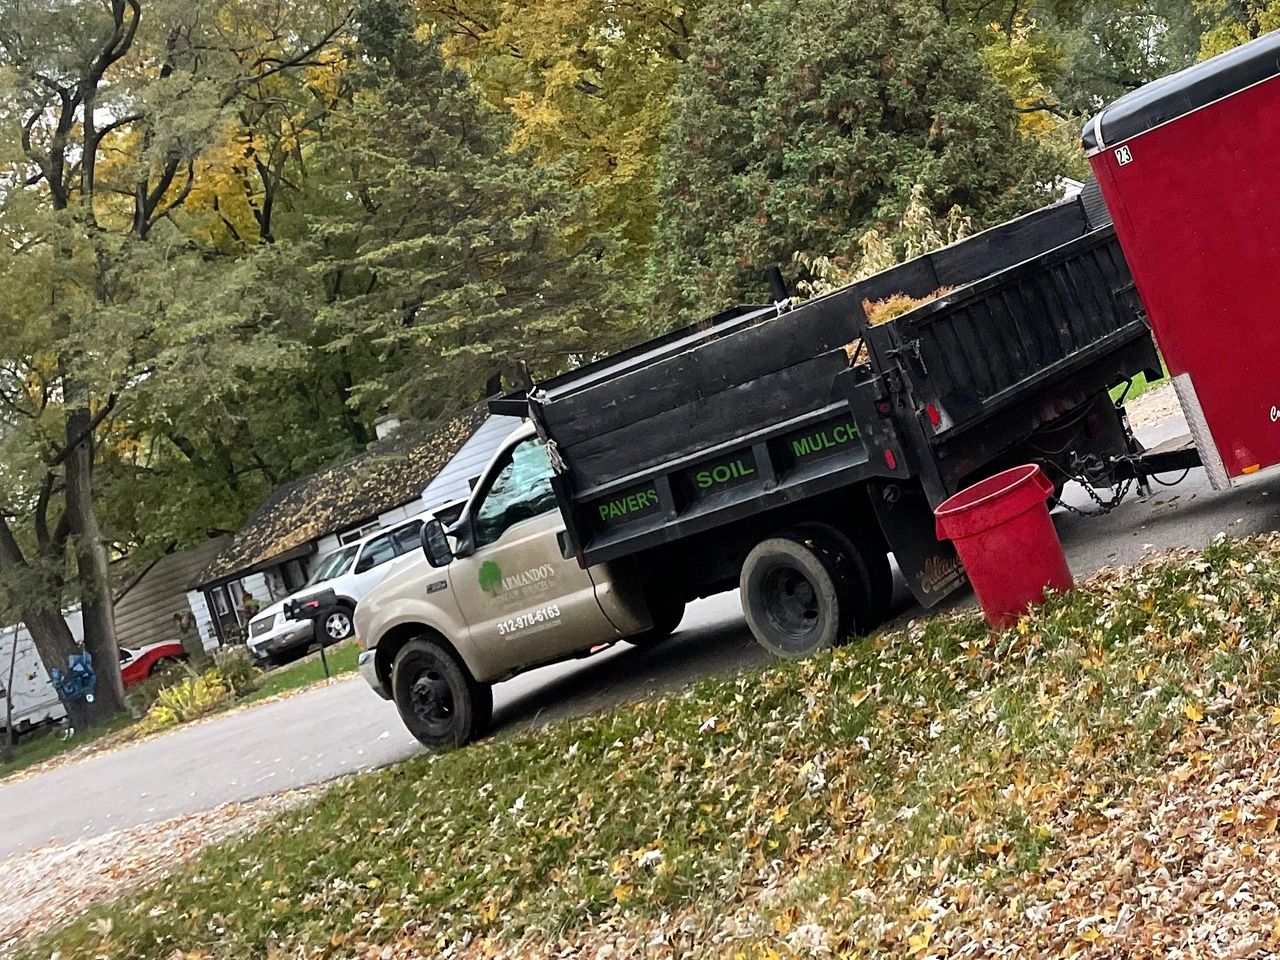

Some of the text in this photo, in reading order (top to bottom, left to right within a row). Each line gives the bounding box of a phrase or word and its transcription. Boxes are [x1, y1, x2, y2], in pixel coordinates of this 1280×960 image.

[1116, 147, 1132, 165] 23
[598, 422, 862, 520] PAVERS SOIL MULCH
[501, 563, 555, 592] ARMANDO'S
[496, 604, 561, 636] 312-978-6163
